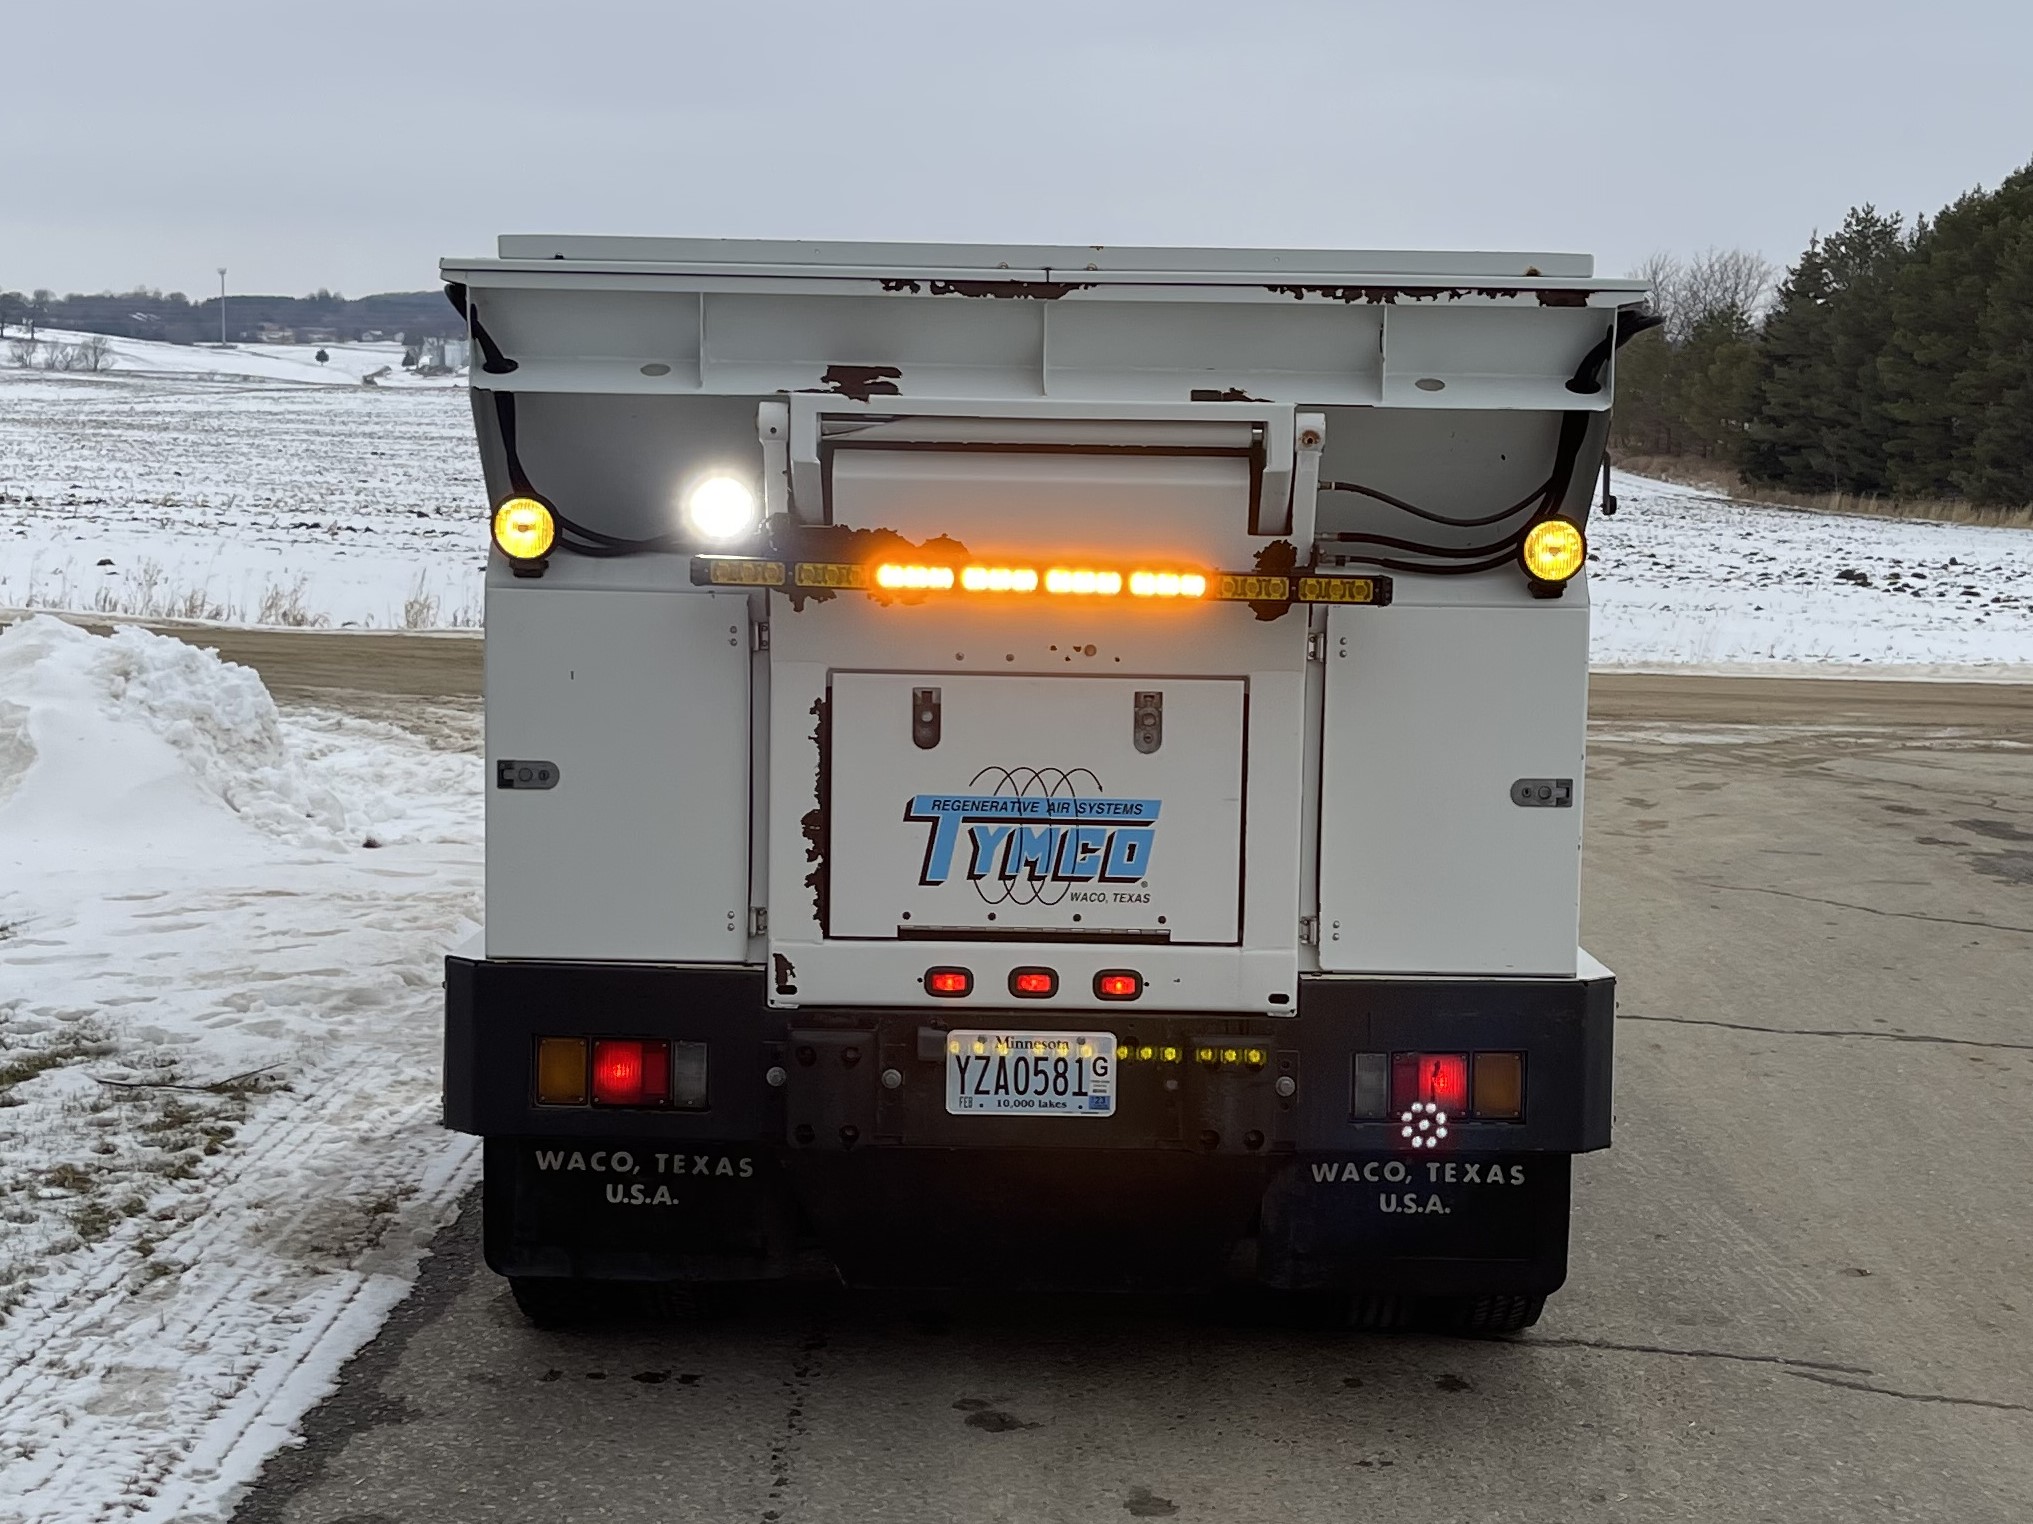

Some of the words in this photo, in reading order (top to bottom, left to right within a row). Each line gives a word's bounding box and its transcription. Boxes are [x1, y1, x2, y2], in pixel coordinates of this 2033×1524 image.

[931, 799, 1040, 813] REGENERATIVE
[1046, 801, 1070, 814] AIR
[1077, 802, 1144, 816] SYSTEMS
[903, 794, 1162, 886] TYMCO
[1070, 891, 1109, 905] WACO,
[1112, 892, 1151, 904] TEXAS
[994, 1035, 1070, 1050] Minnesota
[955, 1055, 1088, 1097] YZA0581
[1092, 1056, 1109, 1077] G
[959, 1096, 973, 1108] FEB
[996, 1099, 1035, 1109] 10,000
[1038, 1099, 1067, 1109] lakes
[535, 1150, 640, 1175] WACO,
[655, 1153, 753, 1177] TEXAS
[1311, 1161, 1413, 1184] WACO,
[1426, 1162, 1525, 1185] TEXAS
[606, 1183, 680, 1205] U.S.A.
[1379, 1193, 1451, 1214] U.S.A.
